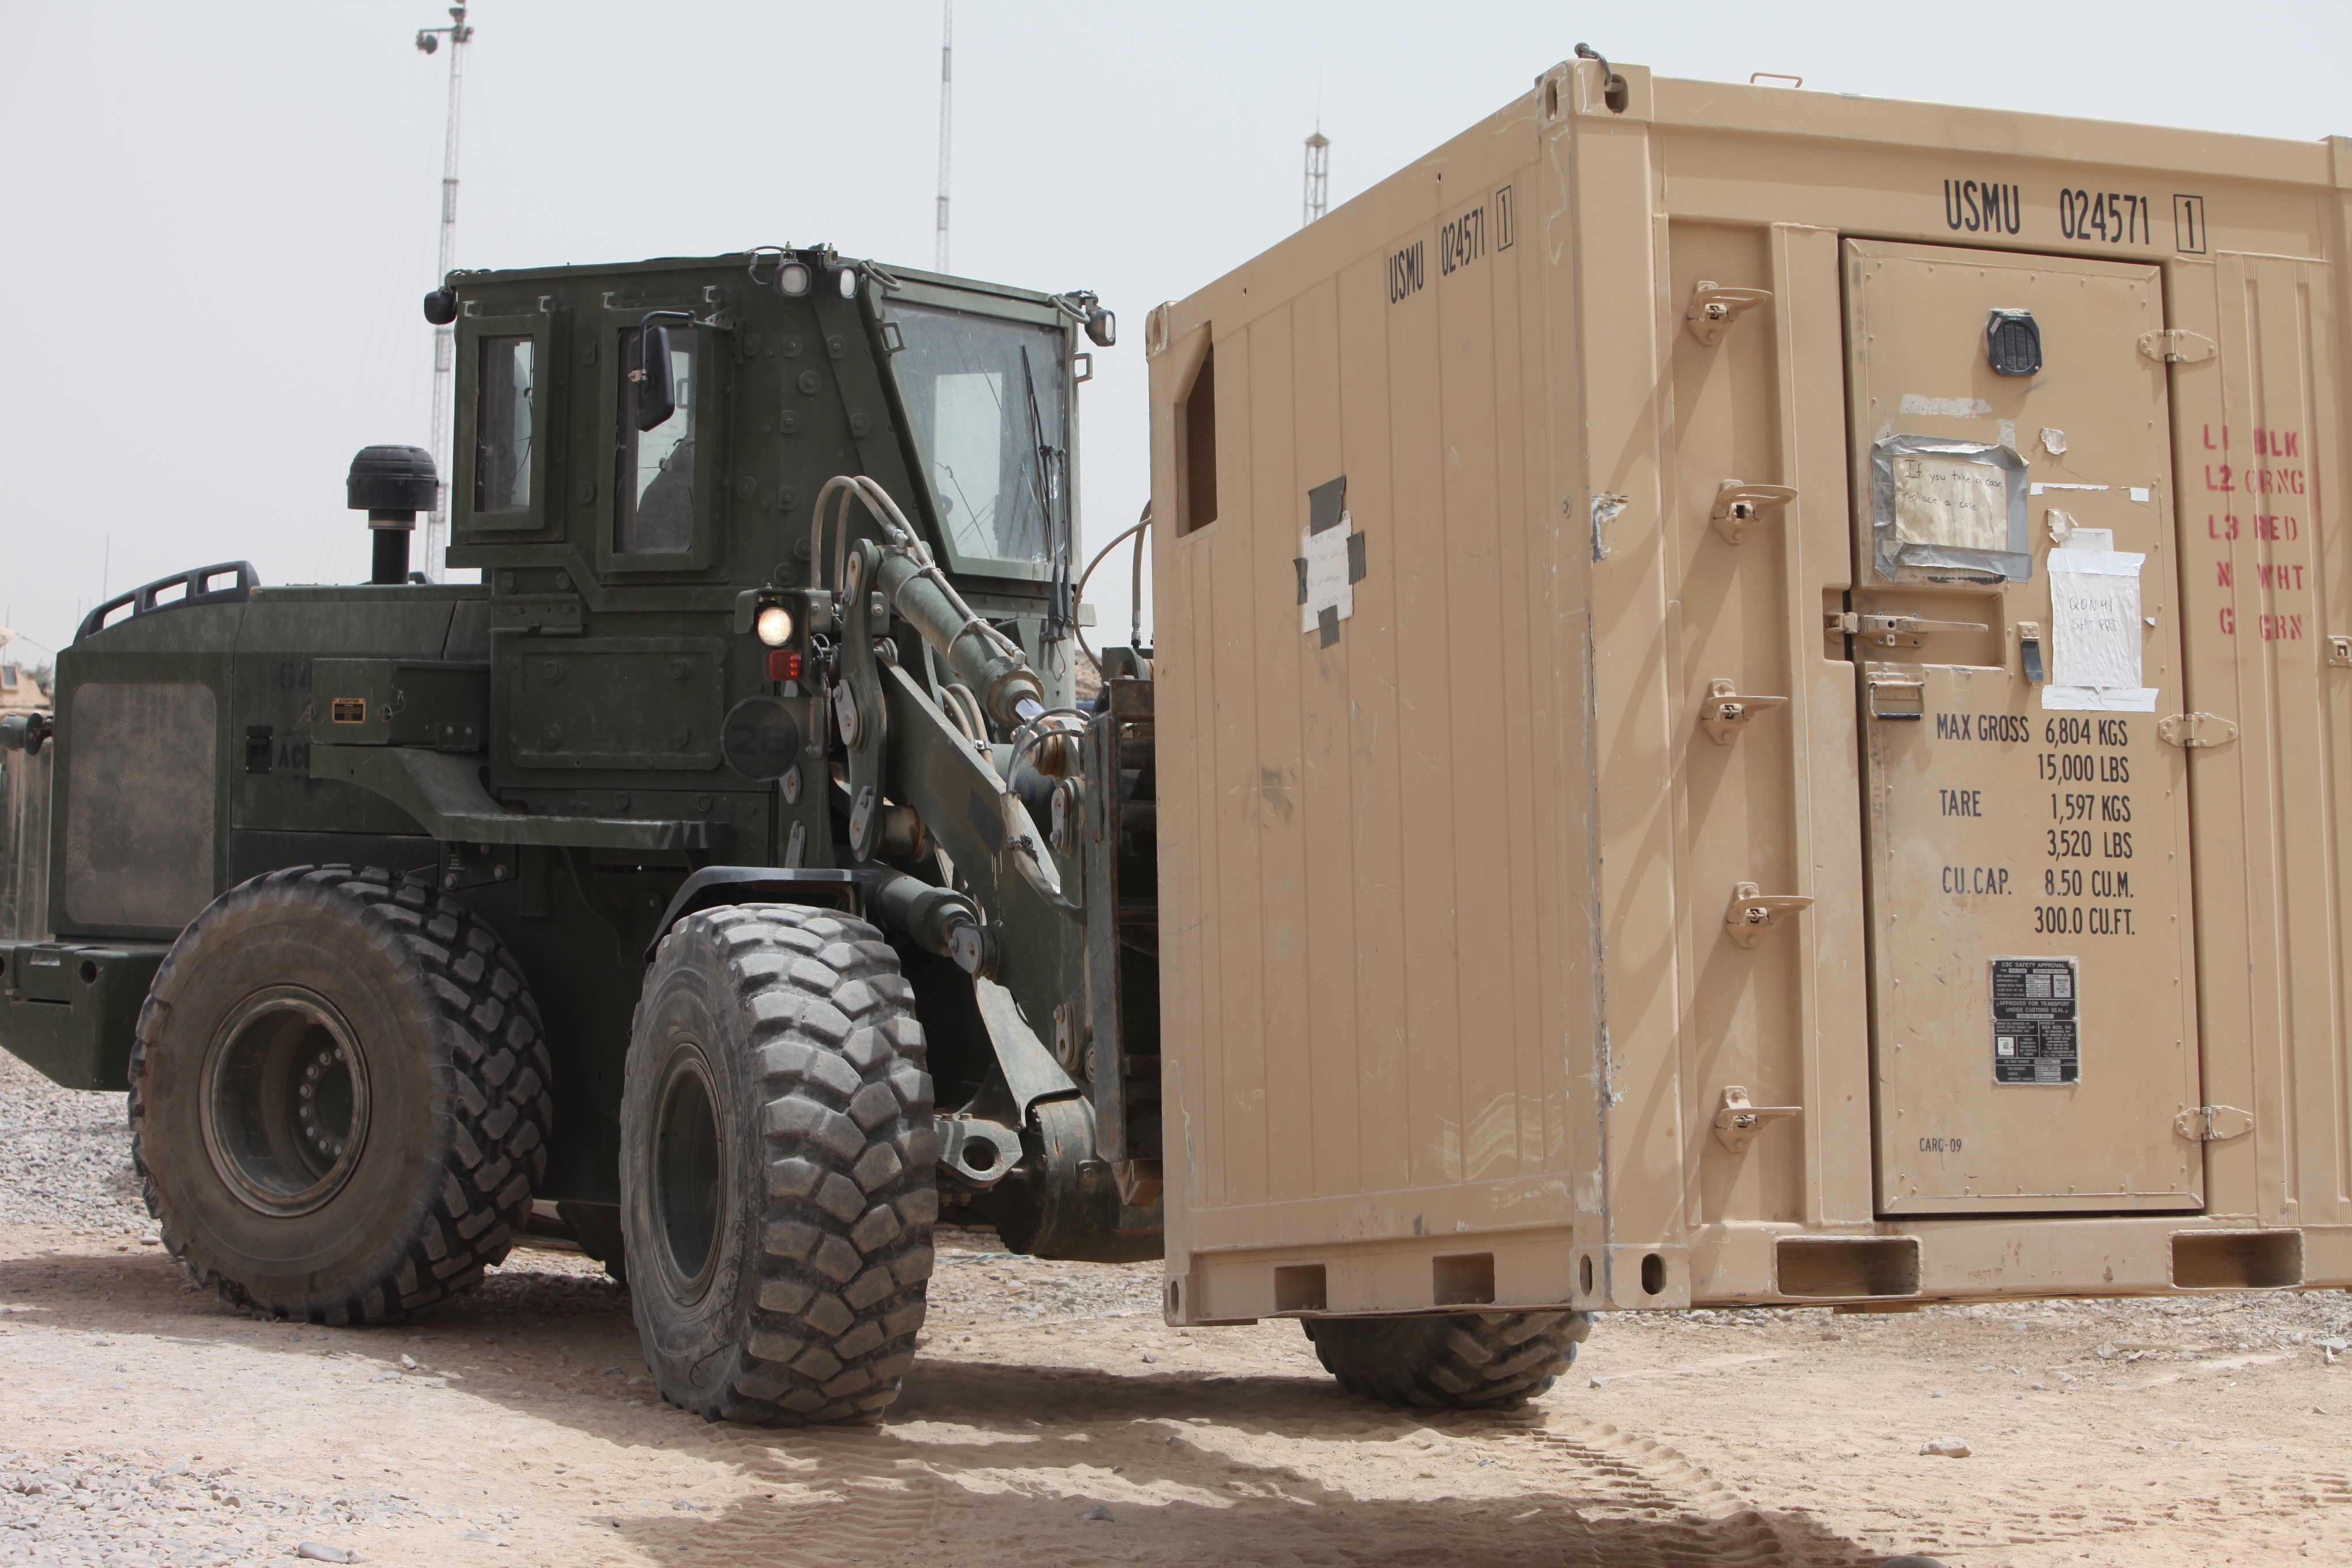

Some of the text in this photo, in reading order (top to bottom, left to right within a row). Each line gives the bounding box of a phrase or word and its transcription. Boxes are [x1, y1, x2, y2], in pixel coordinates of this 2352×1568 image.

[1944, 179, 2194, 248] USMU 024571 1
[1390, 194, 1507, 304] USMU 024571 1
[2253, 428, 2299, 457] BLK
[1905, 459, 1921, 478] If
[1929, 473, 1946, 484] you
[1951, 470, 1970, 483] take
[1985, 479, 2003, 489] case,
[2205, 465, 2305, 495] L2 ORNG
[1904, 492, 1937, 506] replace
[1960, 501, 1978, 511] case.
[2208, 515, 2298, 541] L3 RED
[2217, 561, 2304, 590] N WHT
[2219, 608, 2302, 641] G GRN
[730, 723, 792, 755] 28
[1936, 713, 2128, 748] MAX GROSS 6,804 KGS
[2038, 753, 2129, 785] 15,000 LBS
[1939, 790, 2131, 824] TARE 1,597 KGS
[2047, 830, 2132, 861] 3,520 LBS
[2045, 869, 2082, 896] 8.50
[2091, 870, 2134, 898] CU.M.
[2034, 907, 2135, 935] 300.0 CU.FT.
[1920, 1138, 1961, 1152] CARC-09
